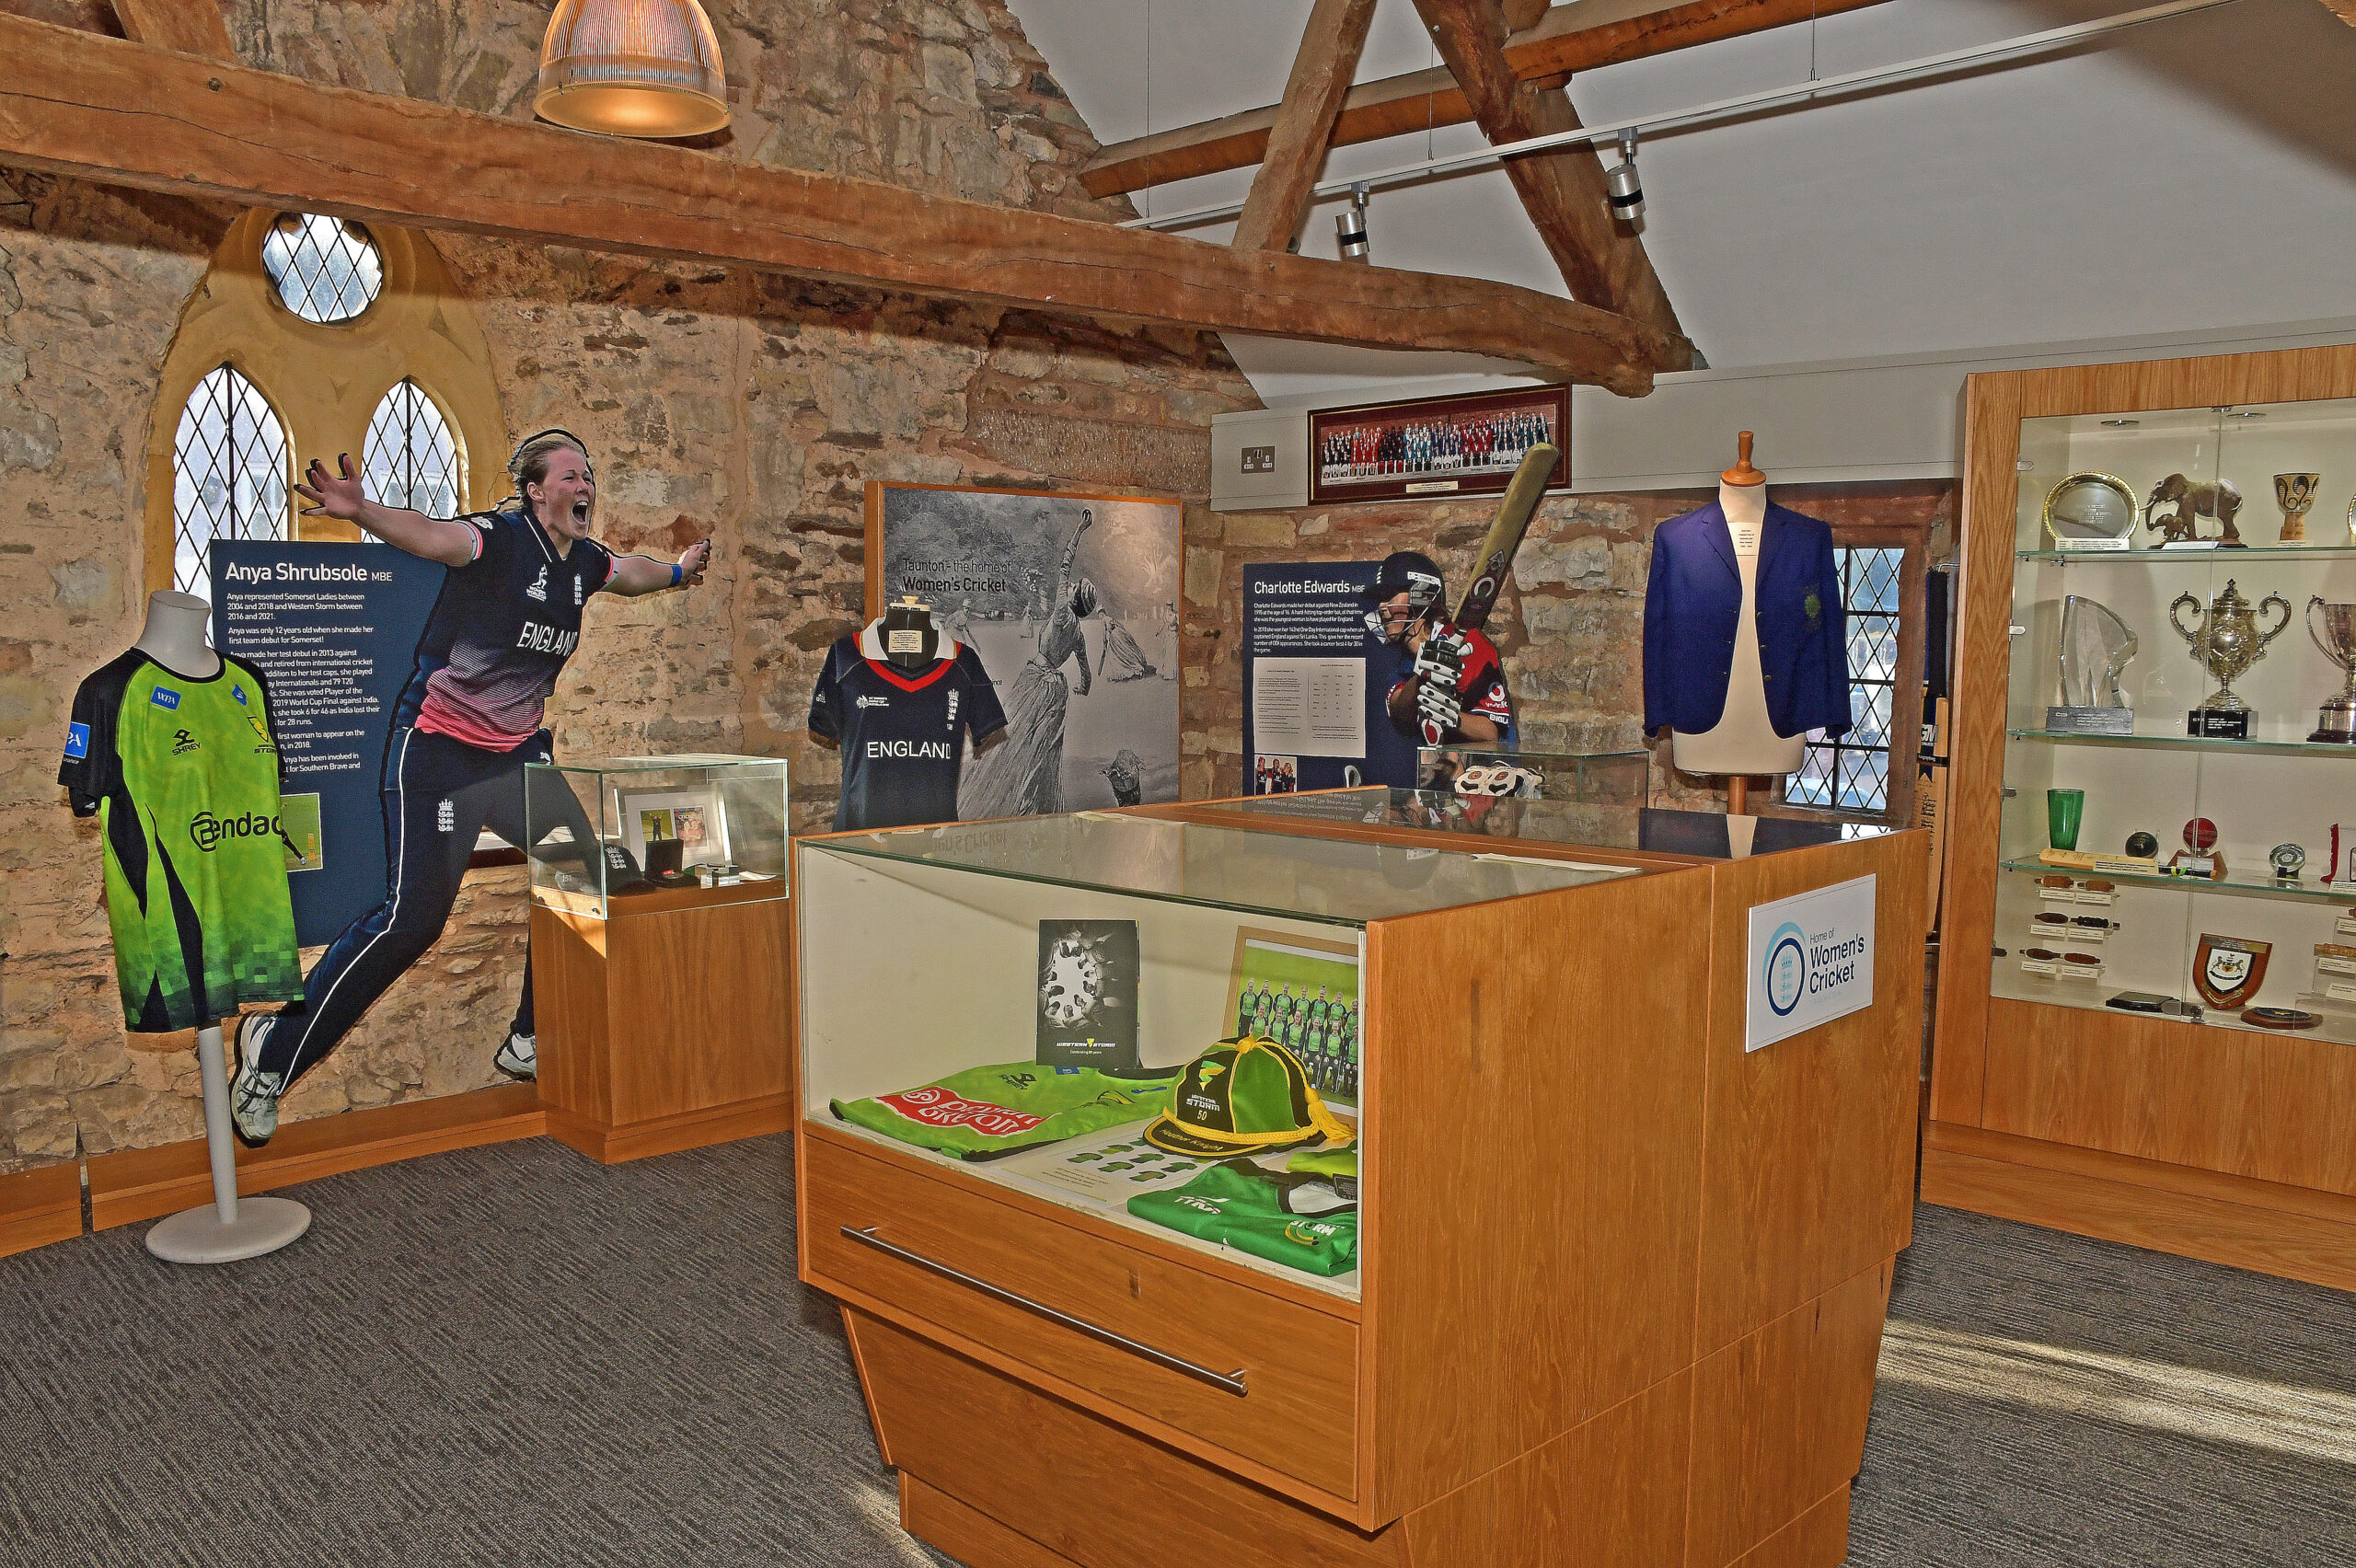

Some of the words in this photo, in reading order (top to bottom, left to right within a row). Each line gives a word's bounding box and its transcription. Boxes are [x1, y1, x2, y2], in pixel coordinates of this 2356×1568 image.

[903, 558, 944, 571] Taunton
[953, 559, 970, 571] the
[972, 559, 999, 572] home
[1001, 560, 1011, 572] of
[225, 562, 271, 584] Anya
[276, 562, 367, 581] Shrubsole
[371, 572, 392, 581] MBE
[903, 576, 960, 592] Women's
[964, 578, 1006, 592] Cricket
[1254, 581, 1301, 594] Charlotte
[1304, 580, 1350, 593] Edwards
[260, 627, 274, 635] only
[516, 621, 578, 657] ENGLAN
[334, 650, 357, 658] against
[352, 668, 373, 676] played
[157, 691, 175, 705] WPA
[339, 697, 363, 705] against
[172, 742, 201, 756] SHREY
[1810, 932, 1828, 945] Home
[1829, 928, 1835, 939] of
[1810, 933, 1865, 969] Women's
[1809, 961, 1855, 994] Cricket
[1185, 1098, 1220, 1112] STORM
[1196, 1110, 1207, 1121] 50
[1290, 1220, 1337, 1237] STORM
